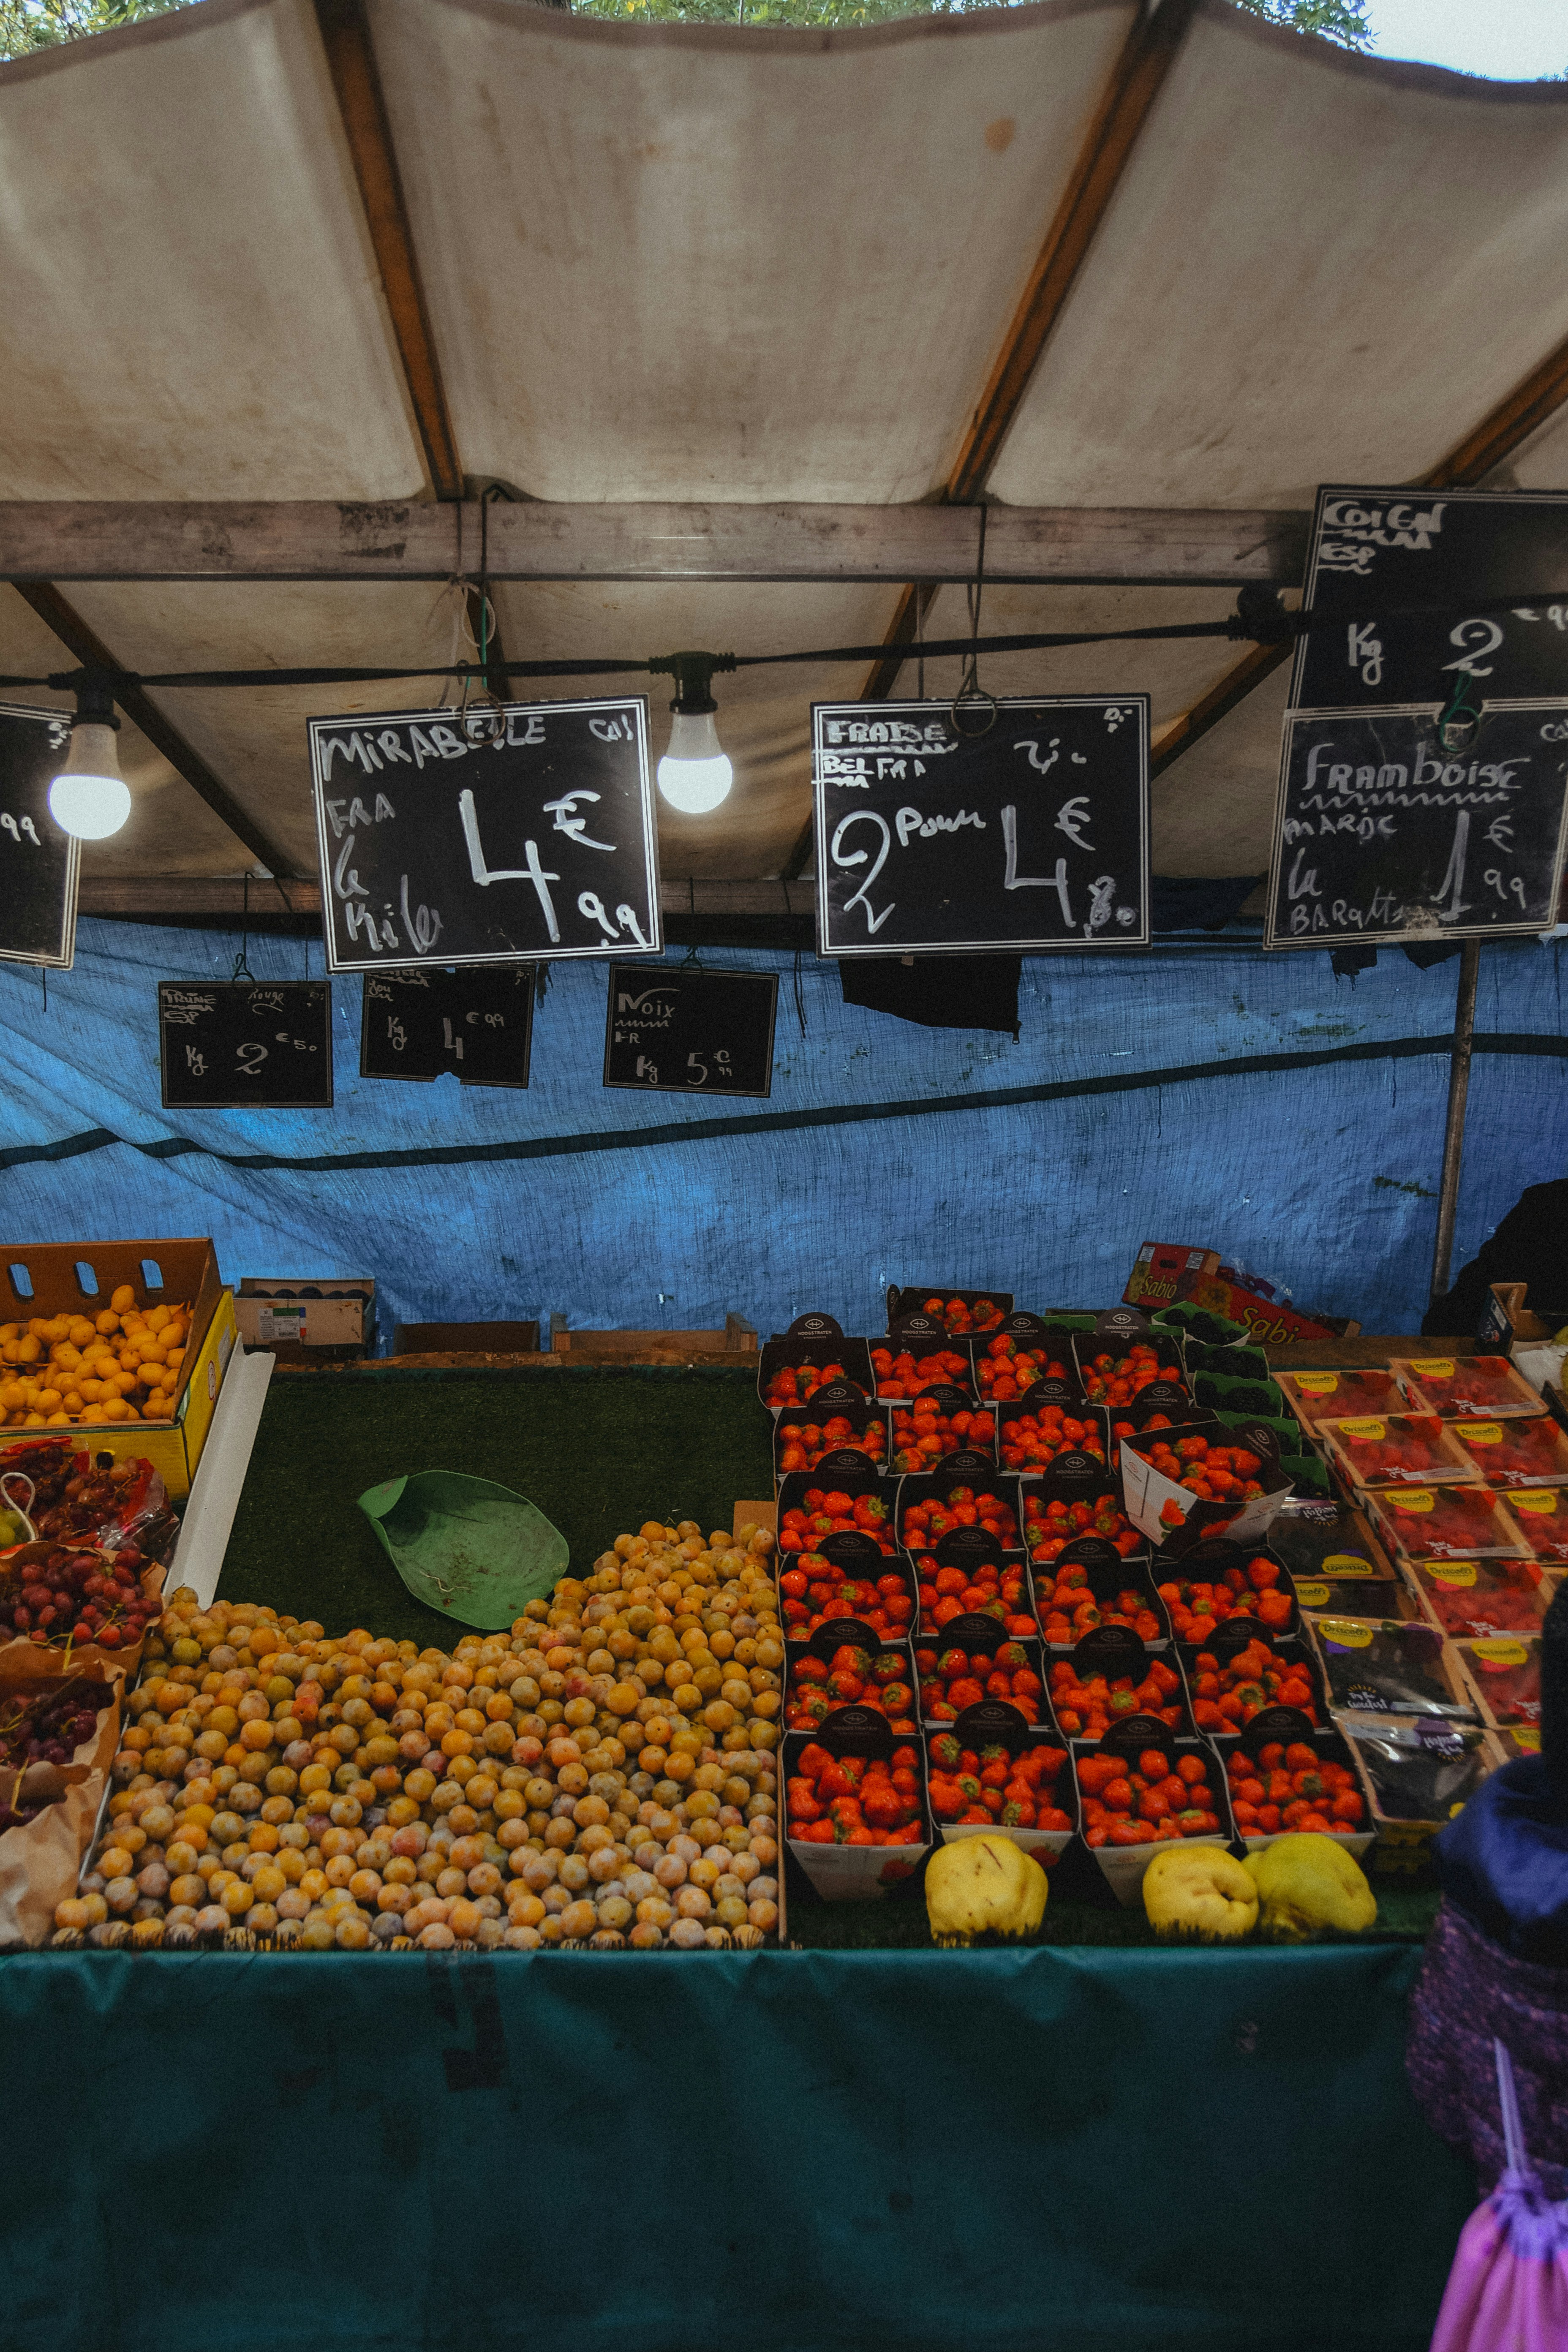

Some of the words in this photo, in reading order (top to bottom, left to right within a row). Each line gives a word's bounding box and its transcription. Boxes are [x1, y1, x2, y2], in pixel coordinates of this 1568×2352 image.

[1348, 622, 1385, 686] Kg
[1440, 619, 1503, 677] 2
[1547, 605, 1568, 631] 9
[1, 813, 41, 846] 99
[1482, 815, 1514, 852] €
[460, 789, 561, 942] 4
[543, 790, 617, 851] €
[831, 810, 895, 934] 2
[1001, 805, 1076, 927] 4
[1054, 797, 1096, 850] €
[1430, 809, 1471, 921] 1
[1484, 868, 1526, 909] 99
[618, 988, 681, 1018] Noix
[388, 1016, 408, 1051] Kg
[443, 1018, 463, 1059] 4
[466, 1012, 480, 1024] €
[485, 1013, 504, 1028] 99
[186, 1045, 208, 1076] Kg
[234, 1043, 269, 1074] 2
[294, 1040, 317, 1051] 50
[637, 1055, 658, 1083] Kg
[687, 1052, 708, 1085] 5
[1140, 1275, 1177, 1299] Sabio
[1236, 1306, 1307, 1344] Sabi
[1324, 1623, 1368, 1636] Driscoll's
